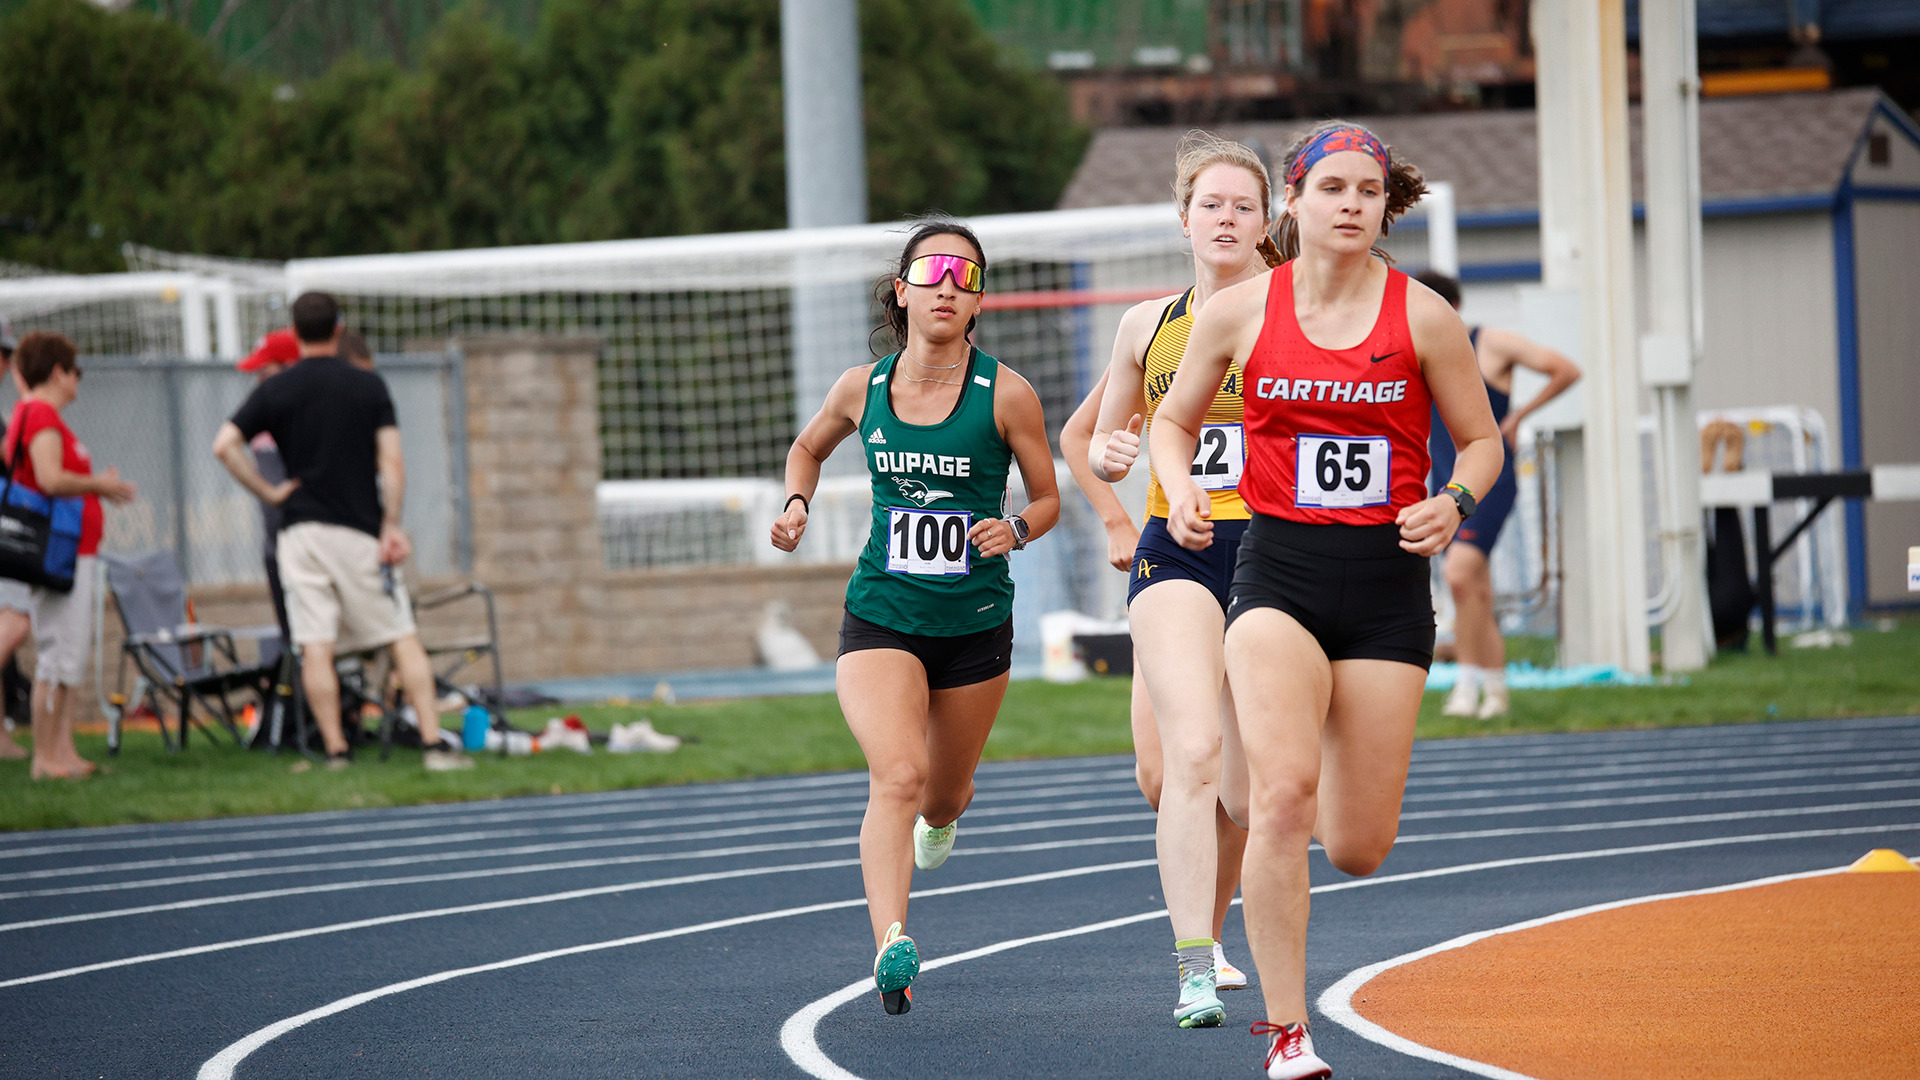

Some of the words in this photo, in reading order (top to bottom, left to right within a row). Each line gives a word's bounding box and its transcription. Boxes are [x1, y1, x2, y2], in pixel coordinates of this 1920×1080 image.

[1256, 376, 1408, 404] CARTHAGE
[874, 451, 971, 478] DUPAGE
[1315, 440, 1371, 492] 65
[893, 512, 966, 562] 100
